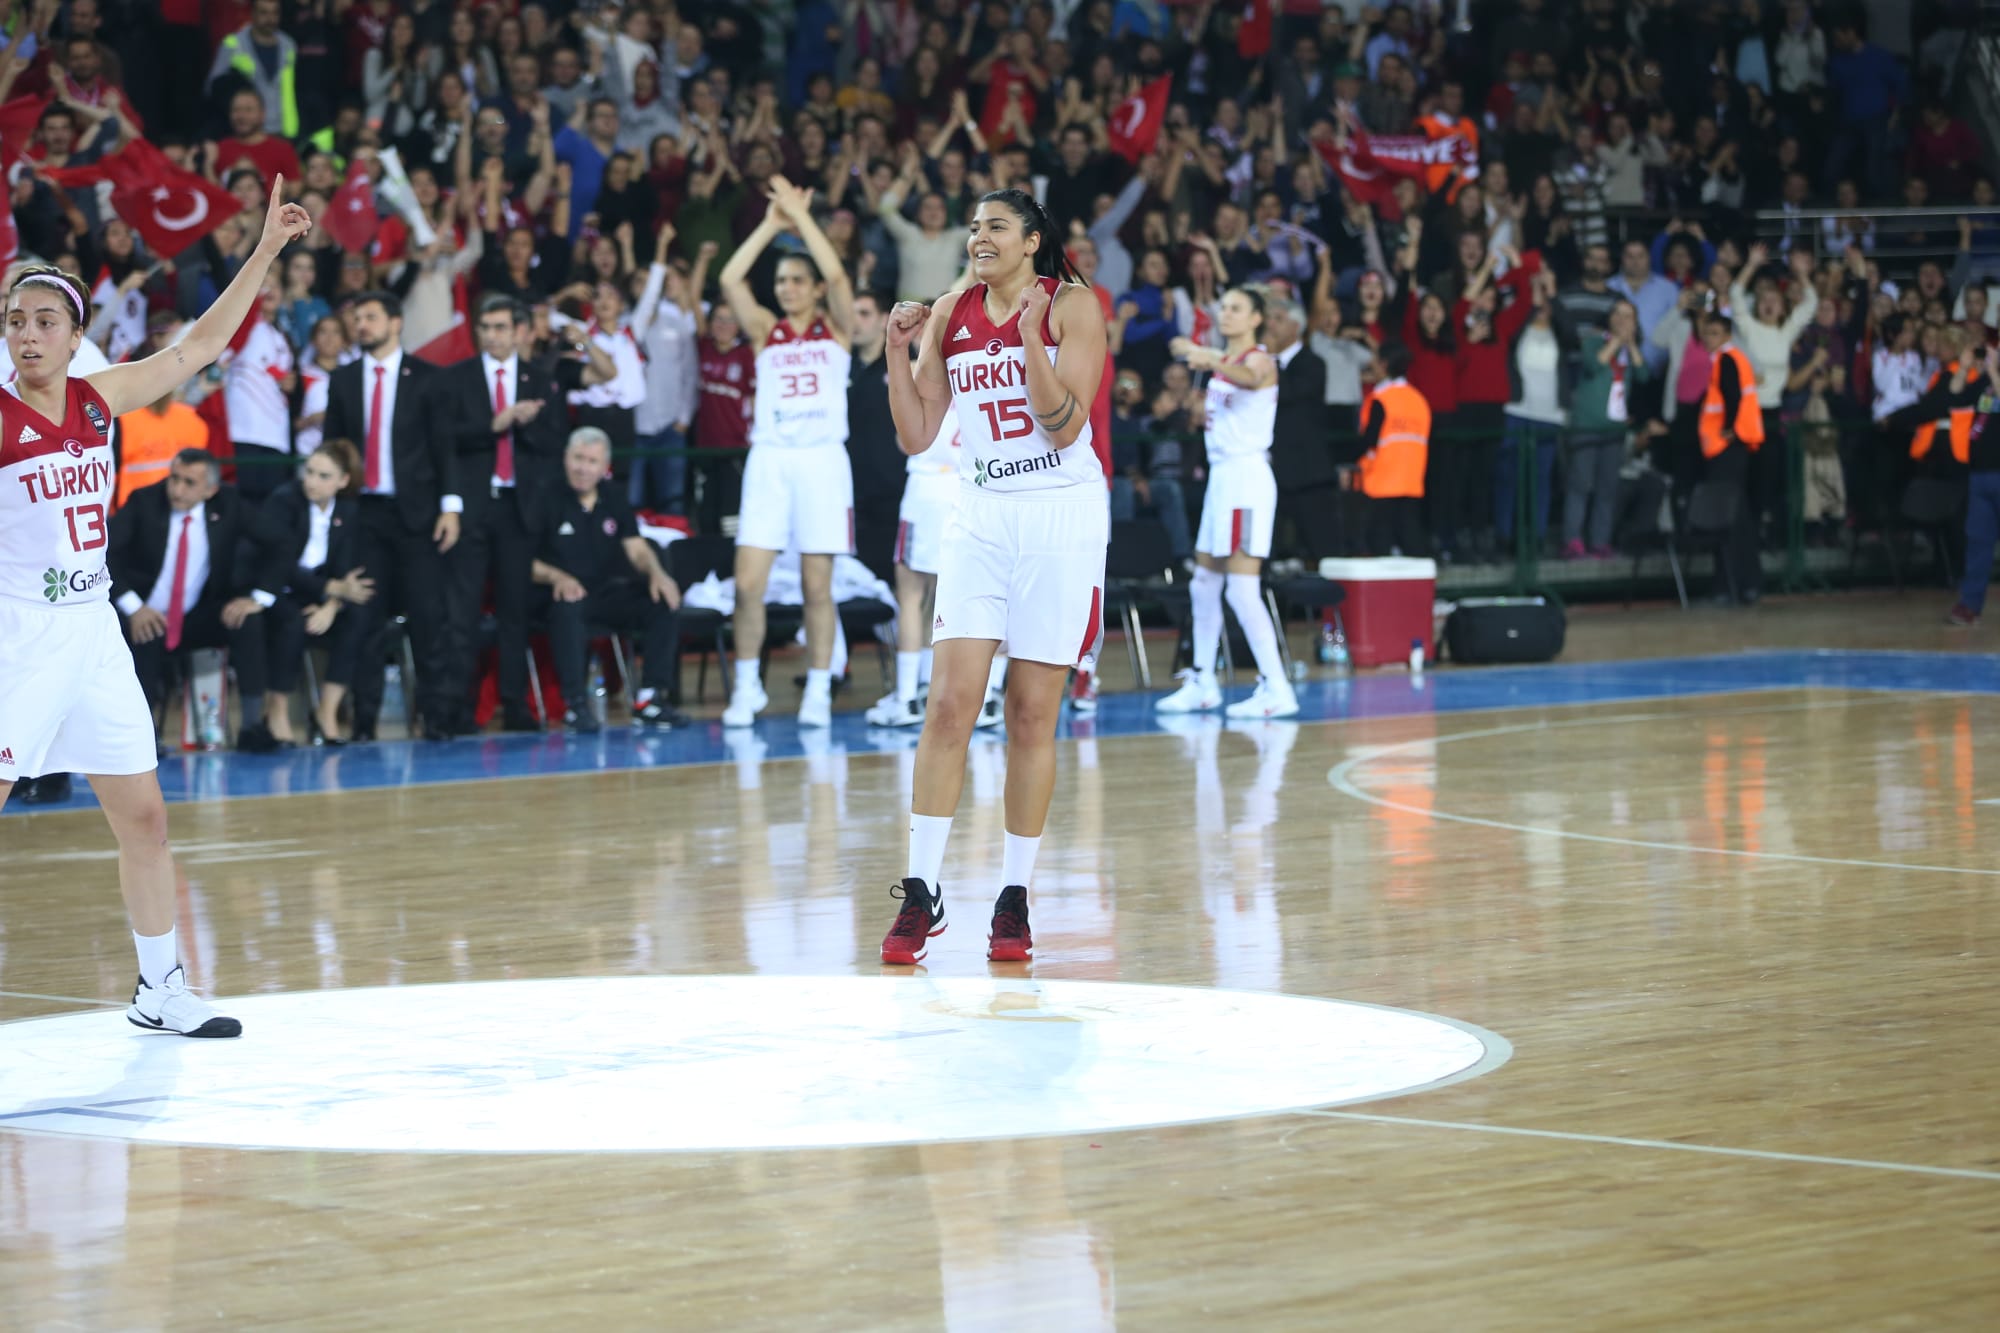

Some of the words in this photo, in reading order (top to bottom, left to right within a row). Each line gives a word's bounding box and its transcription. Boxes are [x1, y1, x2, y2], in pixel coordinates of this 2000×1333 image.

[779, 373, 818, 398] 33
[950, 355, 1026, 395] TÜRKİY
[978, 398, 1034, 442] 15
[19, 457, 111, 503] TÜRKİY
[987, 448, 1062, 479] Garanti
[63, 503, 107, 553] 13
